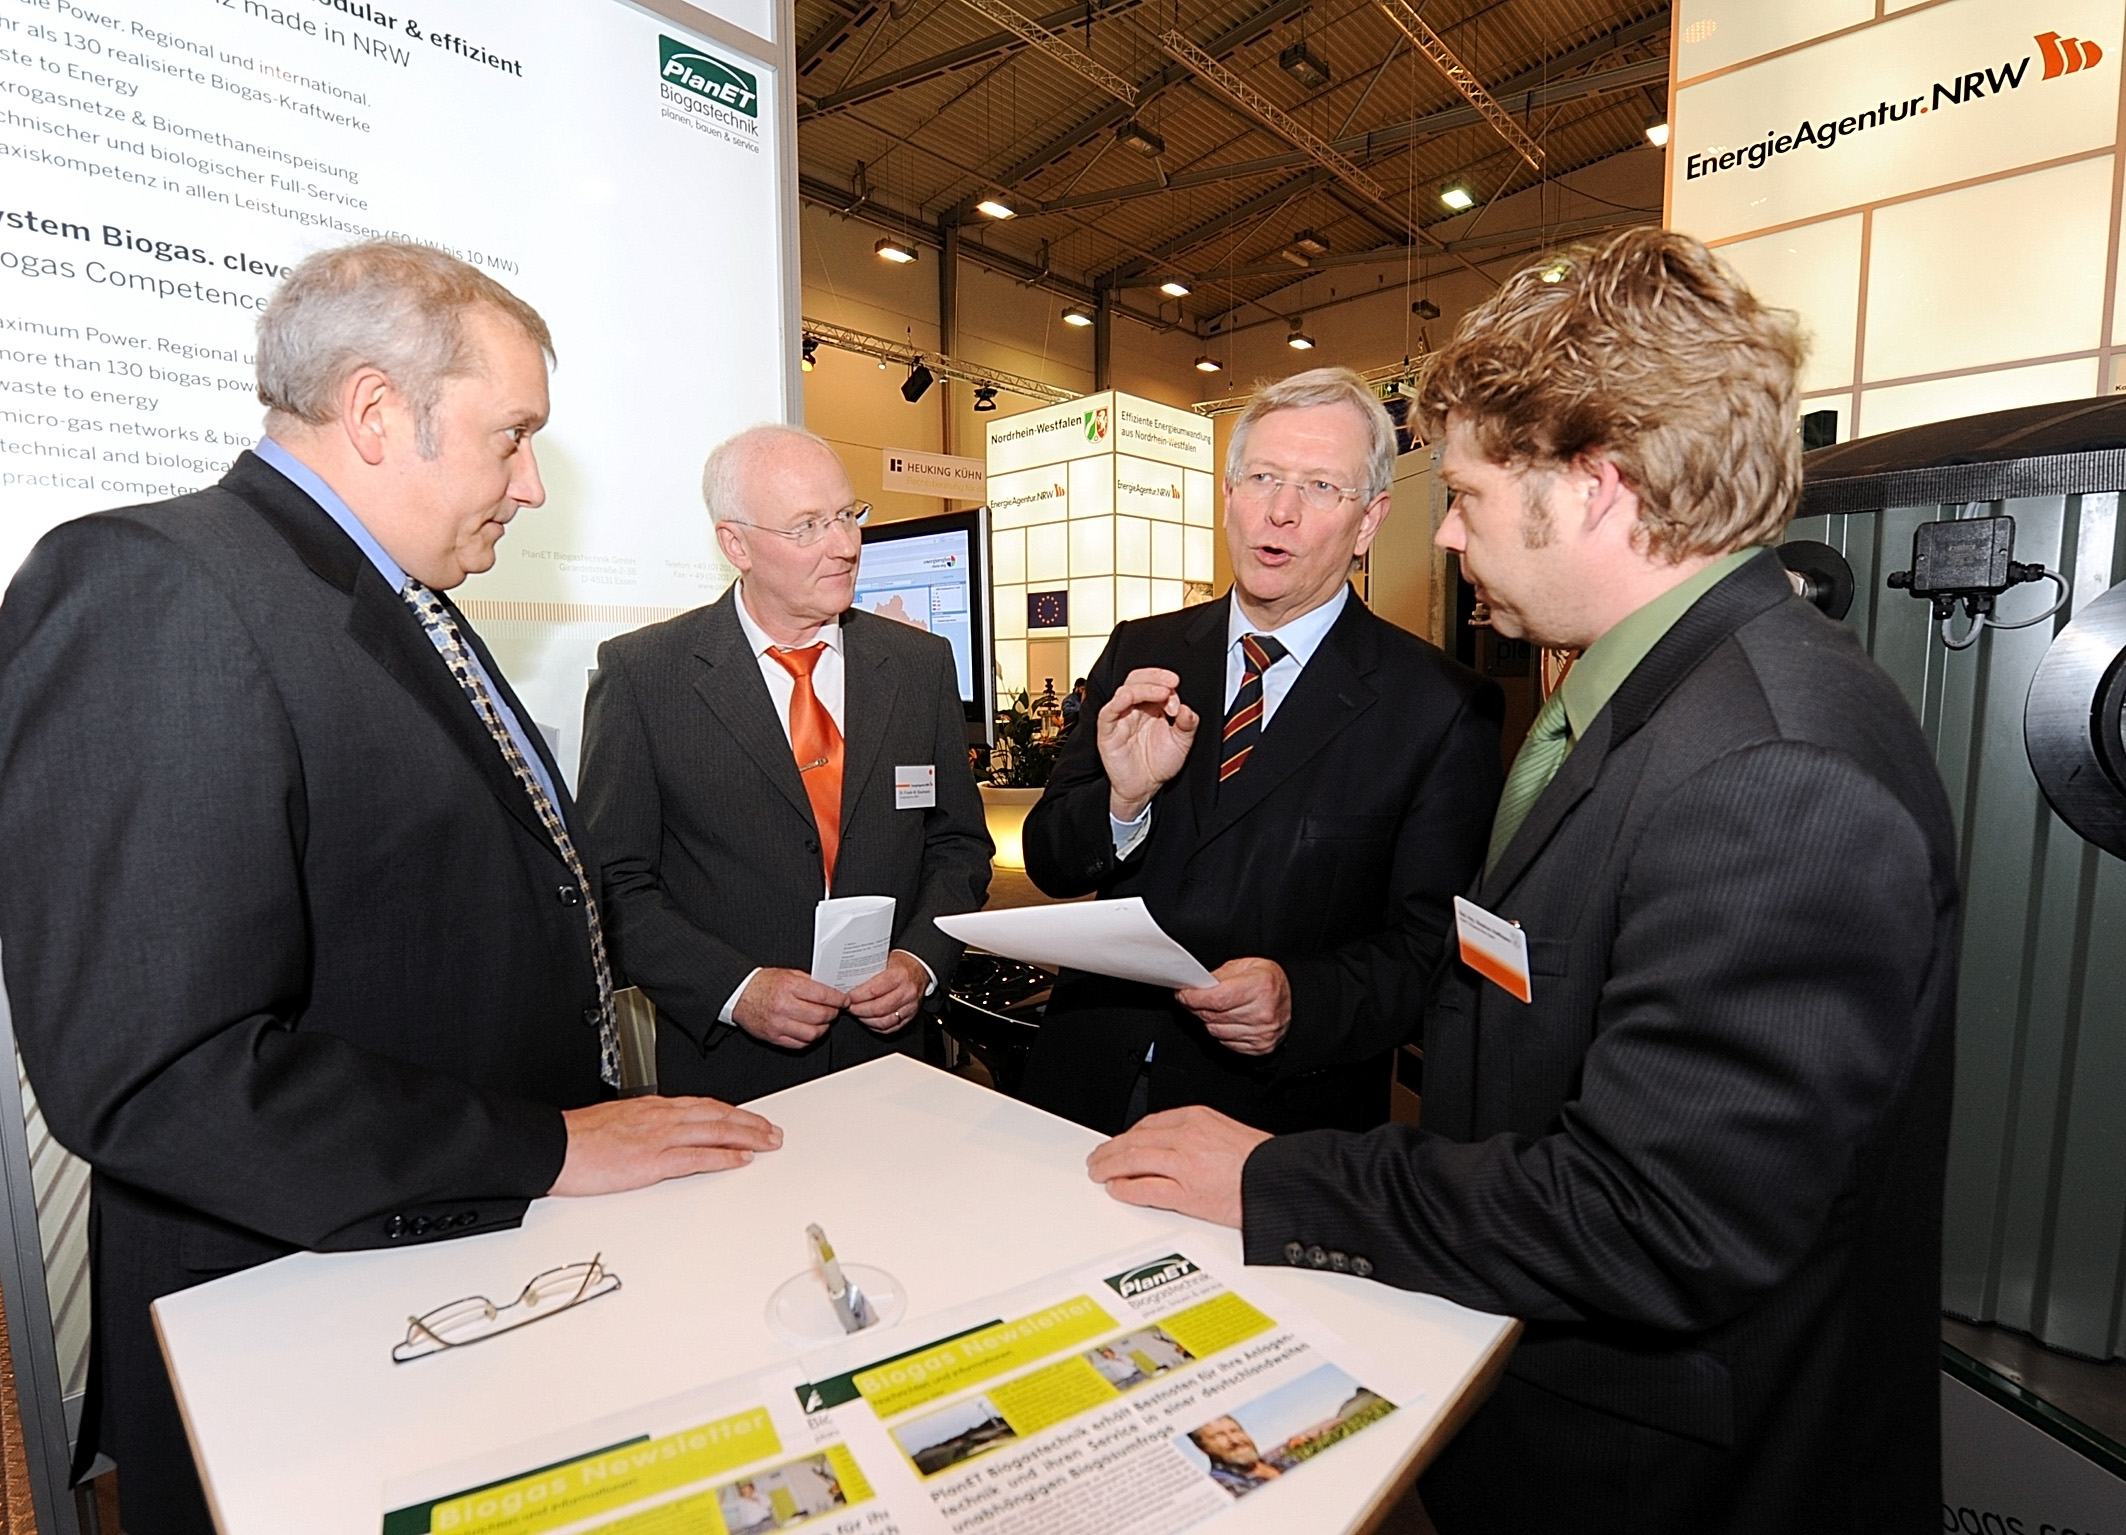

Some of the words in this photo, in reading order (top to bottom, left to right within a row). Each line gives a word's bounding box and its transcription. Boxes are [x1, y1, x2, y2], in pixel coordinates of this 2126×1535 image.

[57, 0, 125, 32] Power.
[131, 21, 215, 60] Regional
[219, 51, 255, 71] und
[258, 60, 372, 108] international.
[245, 0, 316, 36] made
[324, 22, 346, 46] in
[353, 32, 411, 68] NRW
[405, 20, 423, 41] &
[430, 31, 523, 78] effizient
[27, 25, 57, 43] als
[63, 31, 102, 55] 130
[107, 45, 206, 84] realisierte
[211, 74, 371, 134] Biogas-Kraftwerke
[39, 56, 61, 74] to
[67, 63, 139, 98] Energy
[662, 58, 757, 109] PlanET
[660, 82, 759, 138] Biogastechnik
[661, 108, 694, 128] planen,
[695, 119, 723, 139] bauen
[723, 131, 731, 143] &
[732, 136, 760, 154] service
[1686, 56, 2031, 181] EnergieAgentur.NRW
[131, 110, 148, 128] &
[152, 115, 359, 185] Biomethaneinspeisung
[106, 137, 145, 157] und
[150, 146, 266, 185] biologischer
[270, 174, 369, 211] Full-Service
[102, 225, 214, 265] Biogas.
[163, 176, 180, 193] in
[185, 184, 230, 206] allen
[235, 194, 380, 241] Leistungsklassen
[467, 250, 484, 265] 10
[487, 254, 520, 276] MW)
[86, 261, 269, 313] Competence
[86, 326, 152, 350] Power.
[158, 337, 238, 363] Regional
[54, 353, 101, 373] than
[107, 360, 143, 378] 130
[149, 366, 212, 388] biogas
[63, 384, 84, 400] to
[90, 390, 159, 411] energy
[0, 439, 96, 461] technical
[102, 450, 140, 464] and
[109, 420, 200, 442] networks
[204, 429, 219, 444] &
[991, 416, 1082, 445] Nordrhein-Westfalen
[1120, 427, 1134, 438] aus
[1134, 429, 1197, 453] Nordrhein-Westfalen
[1121, 410, 1154, 428] Effiziente
[1154, 418, 1212, 446] Energieumwandlung
[2, 472, 95, 490] practical
[907, 462, 951, 477] HEUKING
[954, 467, 982, 481] KÜHN
[1117, 479, 1171, 499] EnergieAgentur.NRW
[990, 489, 1054, 510] EnergieAgentur.NRW
[1120, 1260, 1190, 1298] PlanET
[862, 1352, 957, 1395] Biogas
[960, 1300, 1094, 1358] Newsletter
[931, 1473, 983, 1502] PlanET
[987, 1426, 1088, 1479] Biogastechnik
[1091, 1406, 1132, 1431] erhält
[1132, 1378, 1199, 1412] Bestnoten
[1197, 1368, 1217, 1383] für
[1243, 1333, 1295, 1361] Anlagen-
[437, 1476, 569, 1531] Biogas
[579, 1413, 767, 1487] Newsletter
[940, 1486, 999, 1519] technik
[1008, 1468, 1038, 1489] und
[1087, 1423, 1139, 1451] Service
[1142, 1413, 1159, 1426] in
[1163, 1395, 1196, 1416] einer
[1068, 1425, 1176, 1480] Biogasumfrage
